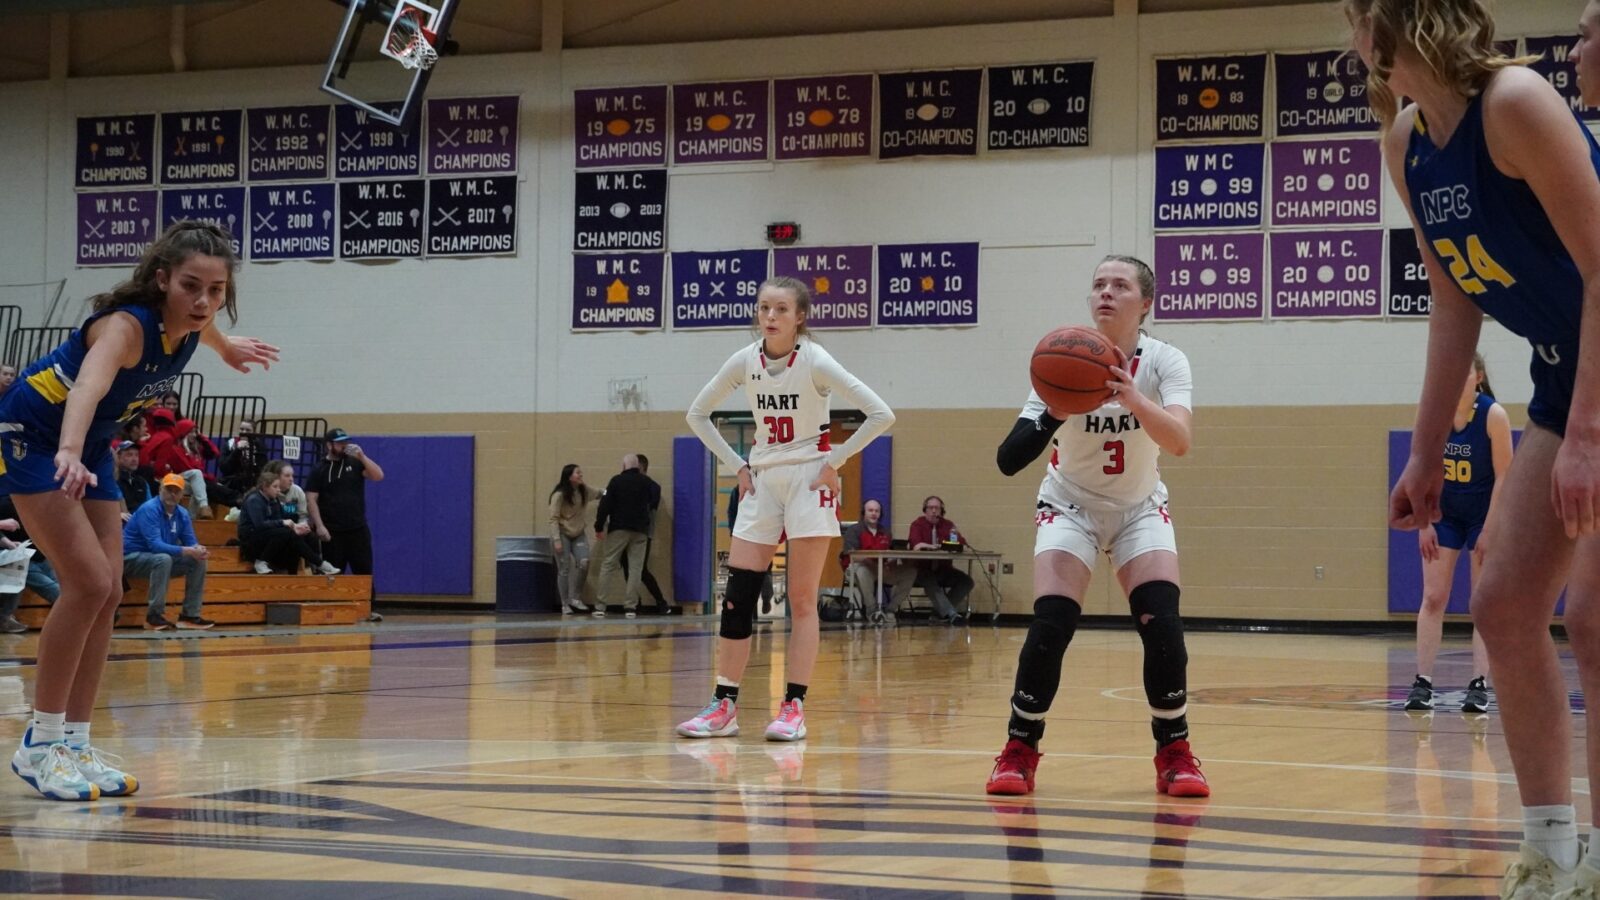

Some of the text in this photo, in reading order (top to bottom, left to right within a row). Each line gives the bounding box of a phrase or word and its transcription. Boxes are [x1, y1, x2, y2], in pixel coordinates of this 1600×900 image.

[993, 96, 1085, 117] 20 10
[686, 113, 756, 132] 19 77
[787, 108, 860, 127] 19 78
[1160, 114, 1259, 133] CO-CHAMPIONS
[1280, 107, 1381, 127] CO-CHAMPION
[466, 129, 494, 144] 2002
[587, 118, 655, 137] 19 75
[276, 135, 309, 151] 1992
[369, 132, 393, 147] 1998
[679, 136, 763, 156] CHAMPIONS
[782, 132, 865, 151] CO-CHAMPIONS
[883, 128, 974, 148] CO-CHAMPIONS
[989, 127, 1088, 147] CO-CHAMPIONS
[580, 140, 663, 160] CHAMPIONS
[251, 155, 325, 173] CHAMPIONS
[338, 154, 417, 172] CHAMPIONS
[434, 153, 511, 170] CHAMPIONS
[82, 166, 147, 182] CHAMPIONS
[167, 164, 235, 179] CHAMPIONS
[1171, 178, 1253, 196] 19 99
[1283, 173, 1369, 192] 20 00
[579, 204, 662, 217] 2013 2013
[1159, 201, 1259, 220] CHAMPIONS
[1276, 199, 1377, 218] CHAMPIONS
[1420, 184, 1473, 225] NPC
[287, 213, 314, 229] 2008
[377, 211, 404, 227] 2016
[468, 208, 496, 224] 2017
[111, 220, 136, 235] 2003
[253, 236, 330, 253] CHAMPIONS
[343, 238, 420, 256] CHAMPIONS
[431, 234, 512, 252] CHAMPIONS
[577, 231, 662, 248] CHAMPIONS
[1432, 234, 1516, 294] 24
[1170, 267, 1251, 286] 19 99
[1283, 264, 1370, 284] 20 00
[586, 285, 650, 297] 19 93
[683, 281, 757, 298] 19 96
[844, 278, 867, 294] 03
[889, 275, 962, 293] 20 10
[882, 299, 973, 317] CHAMPIONS
[1160, 292, 1258, 311] CHAMPIONS
[1276, 289, 1377, 309] CHAMPIONS
[580, 307, 655, 323] CHAMPIONS
[757, 393, 799, 410] HART
[763, 416, 795, 444] 30
[1103, 440, 1125, 475] 3
[1444, 443, 1471, 457] NPC
[1443, 458, 1471, 483] 30
